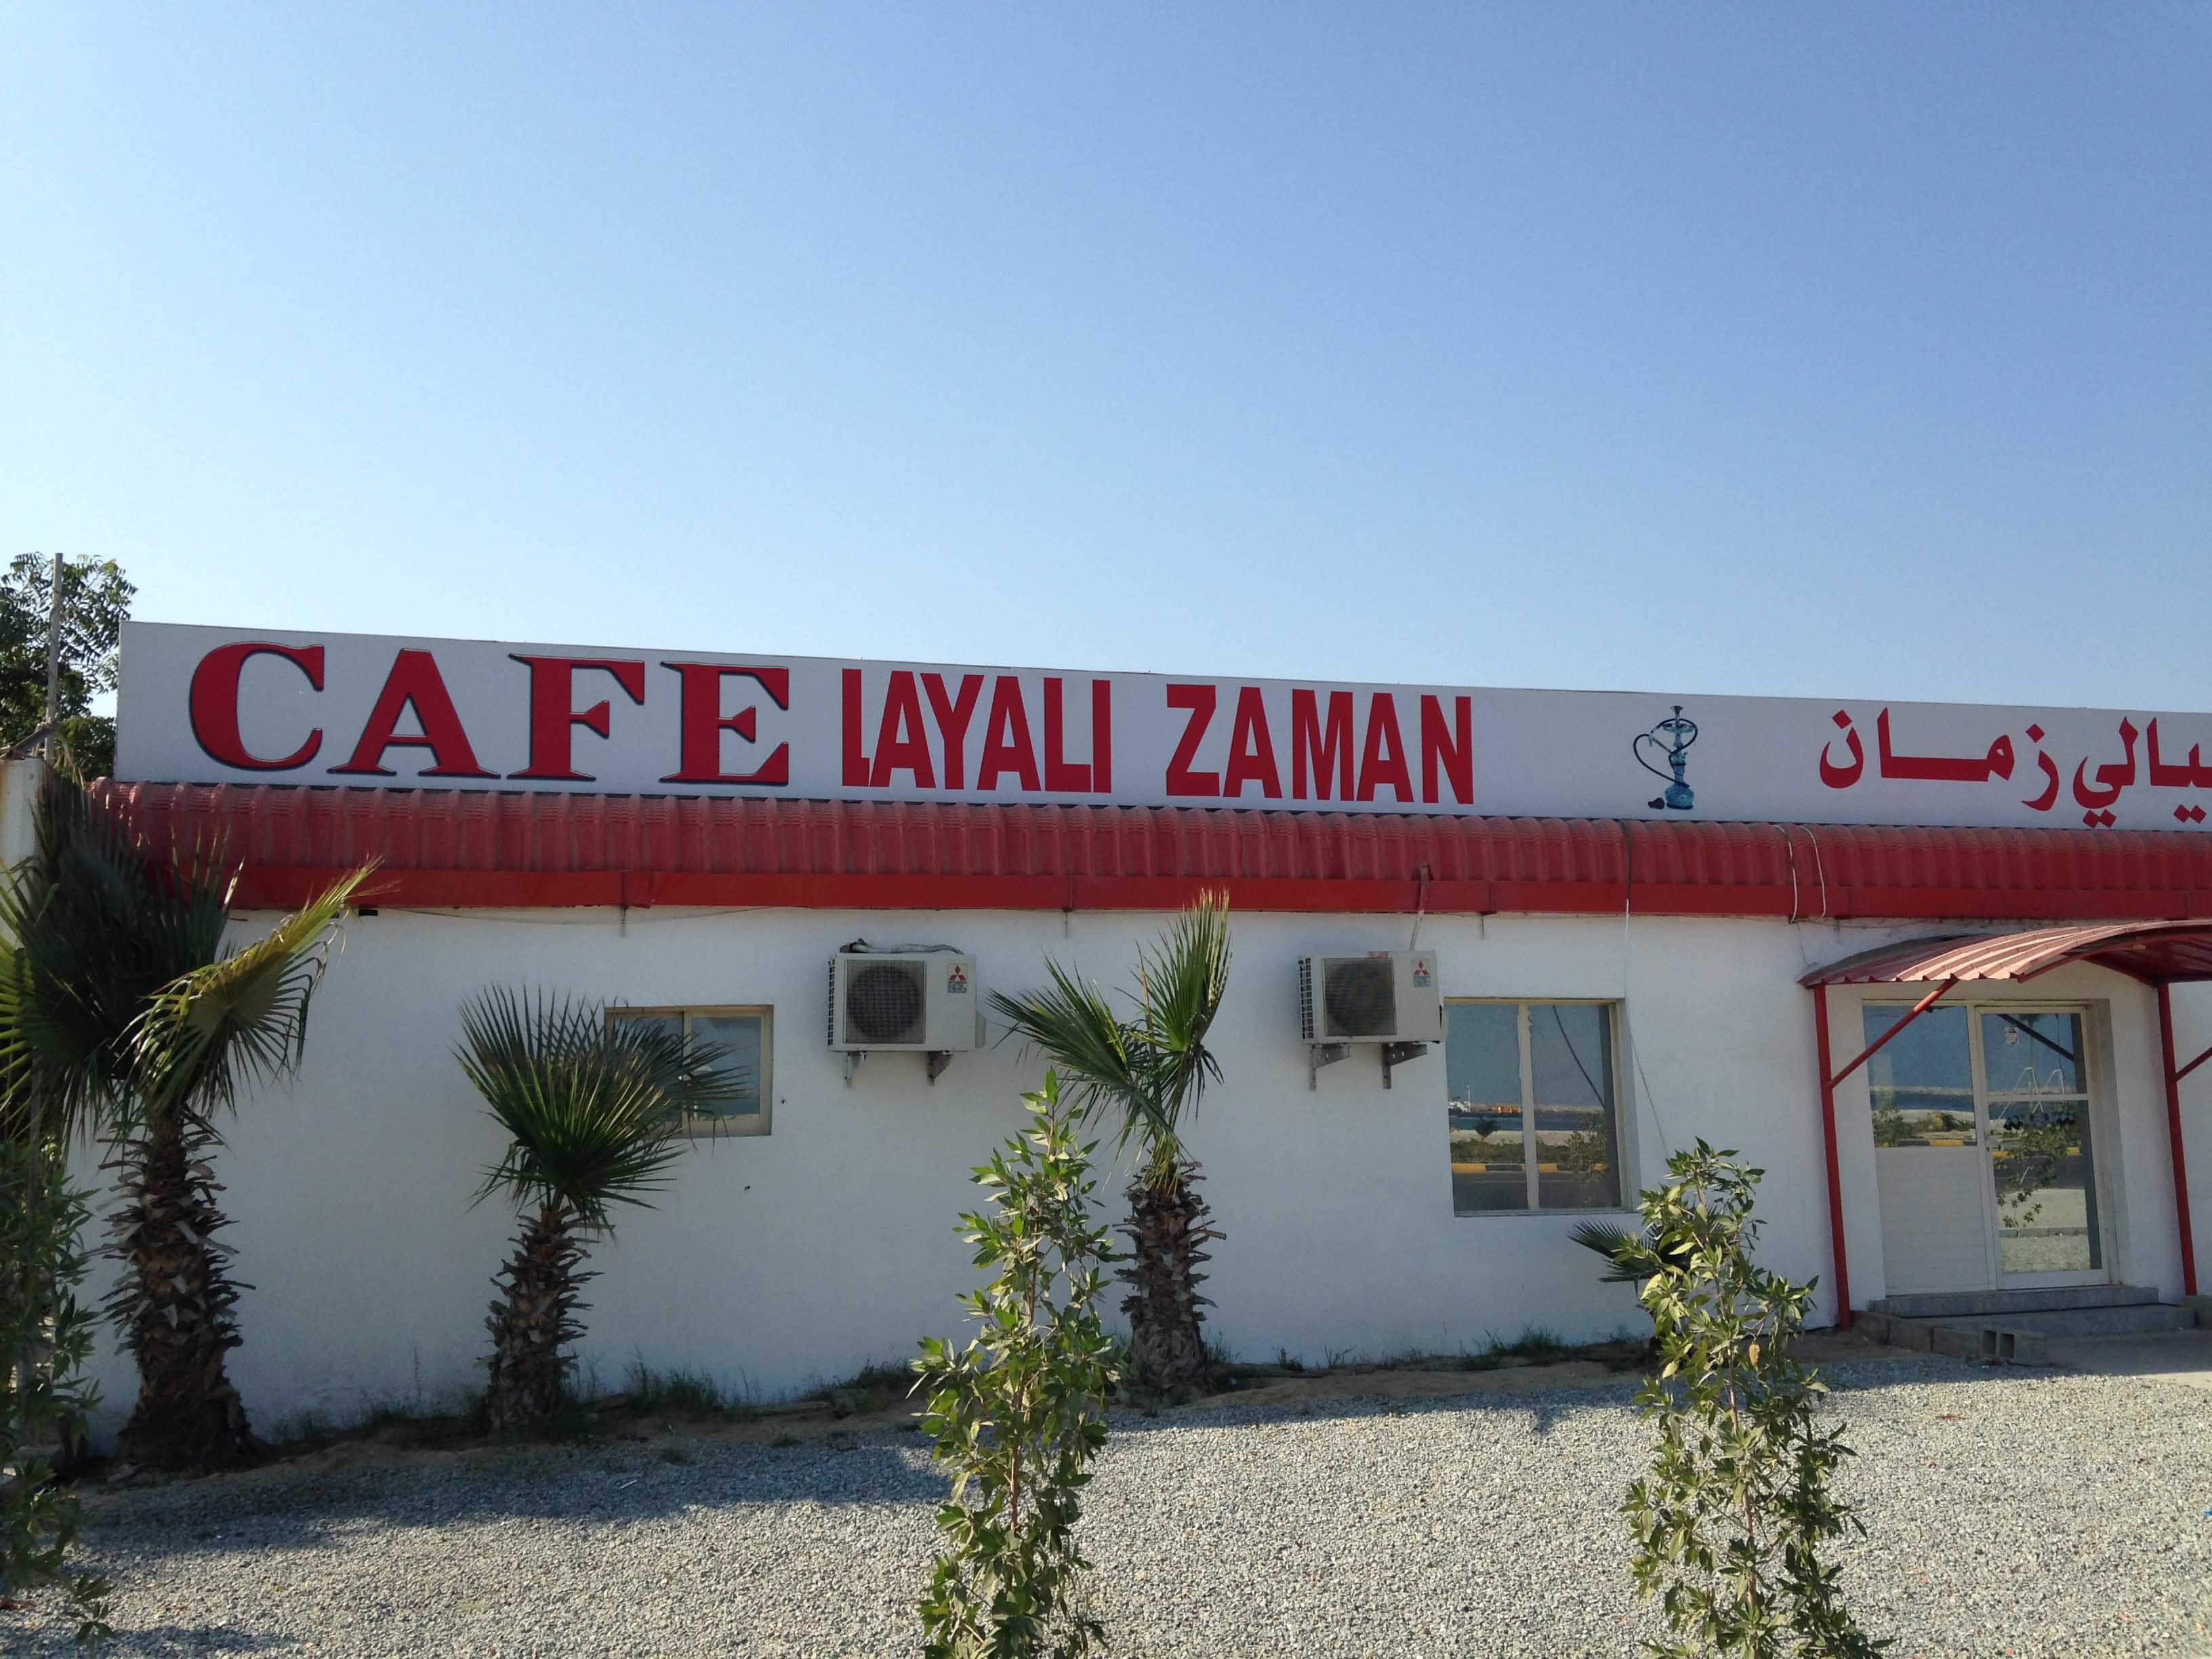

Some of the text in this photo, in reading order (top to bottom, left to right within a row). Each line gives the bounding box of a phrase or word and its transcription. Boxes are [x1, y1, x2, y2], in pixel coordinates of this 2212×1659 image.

[189, 641, 1474, 805] CAFE LAYALI ZAMAN
[1819, 706, 2212, 829] يالي زمان
